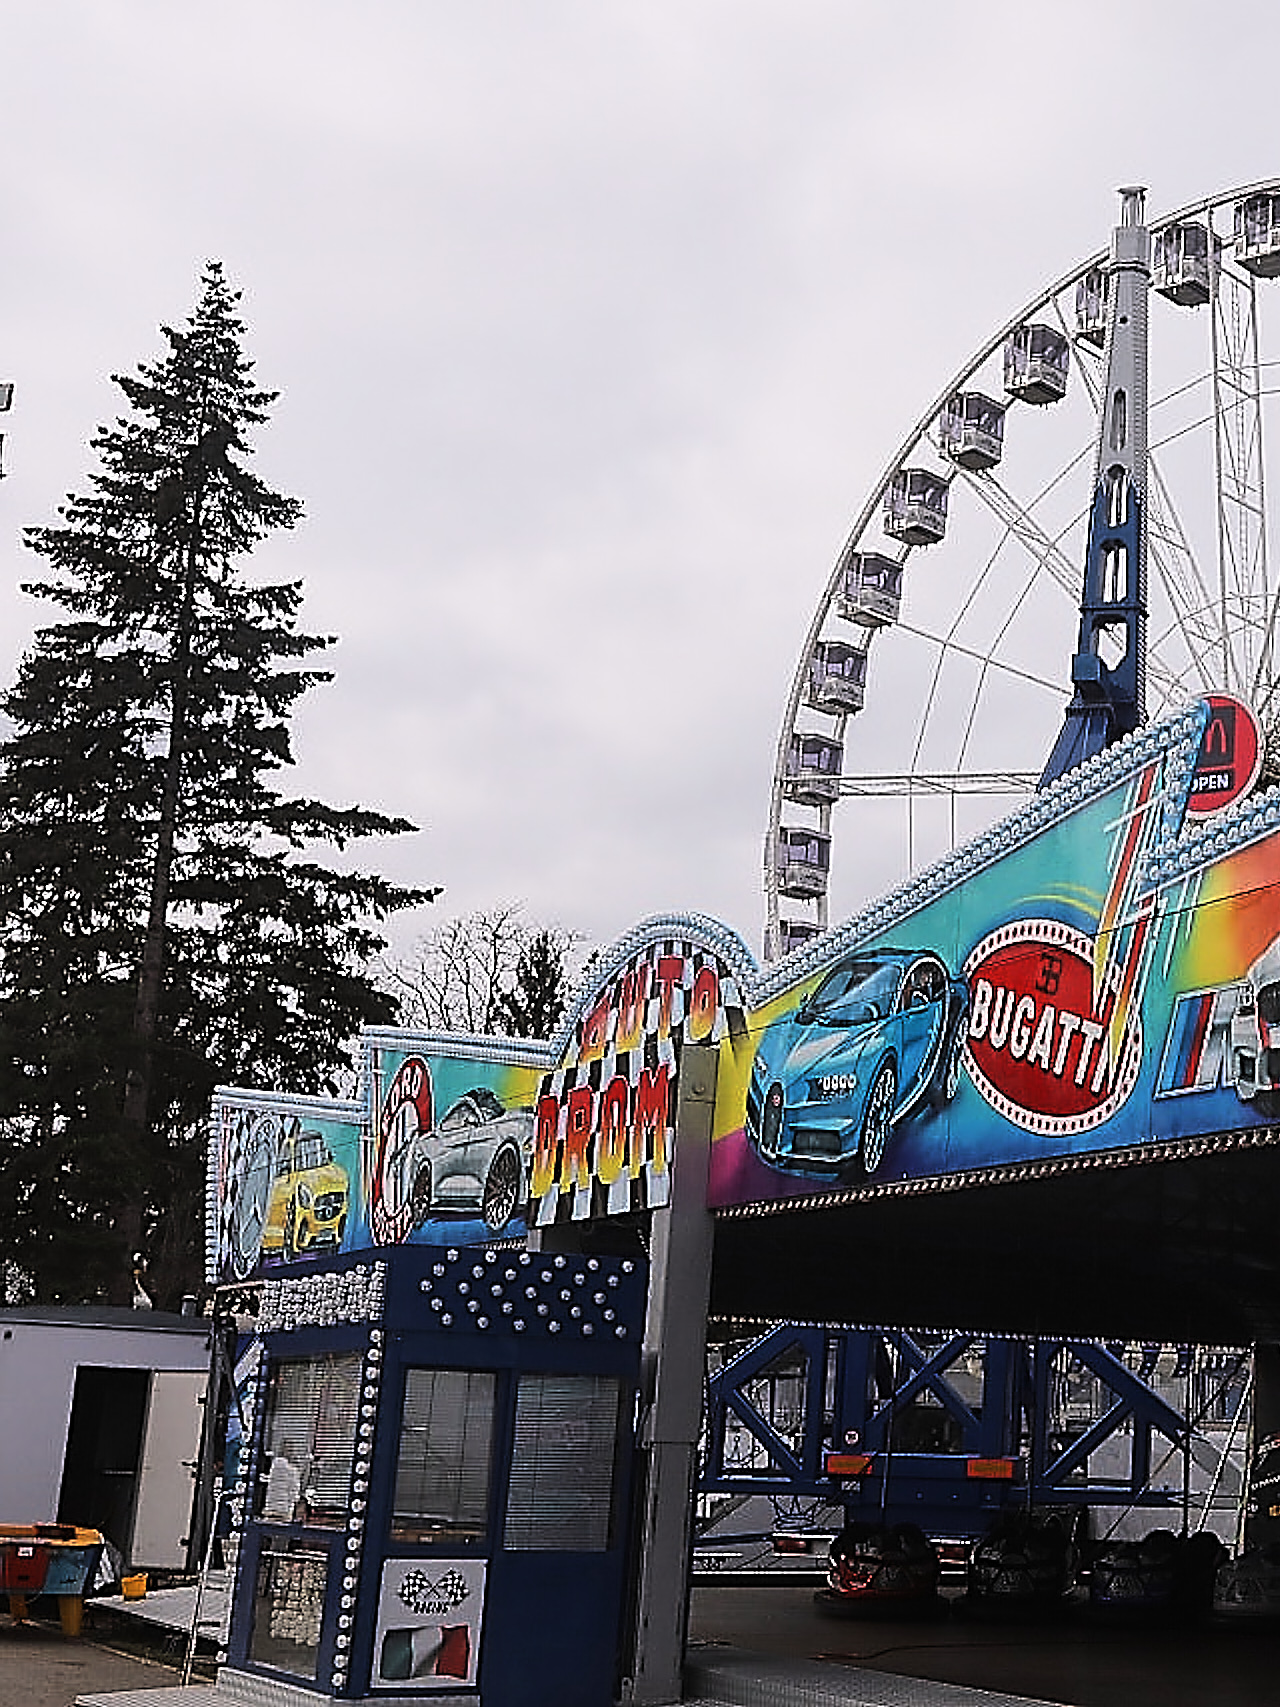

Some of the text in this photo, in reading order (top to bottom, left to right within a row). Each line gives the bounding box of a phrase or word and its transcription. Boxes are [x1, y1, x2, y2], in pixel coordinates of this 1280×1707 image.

[579, 955, 719, 1063] AUTO
[969, 978, 1110, 1093] BUGATTI
[529, 1062, 671, 1199] DROM
